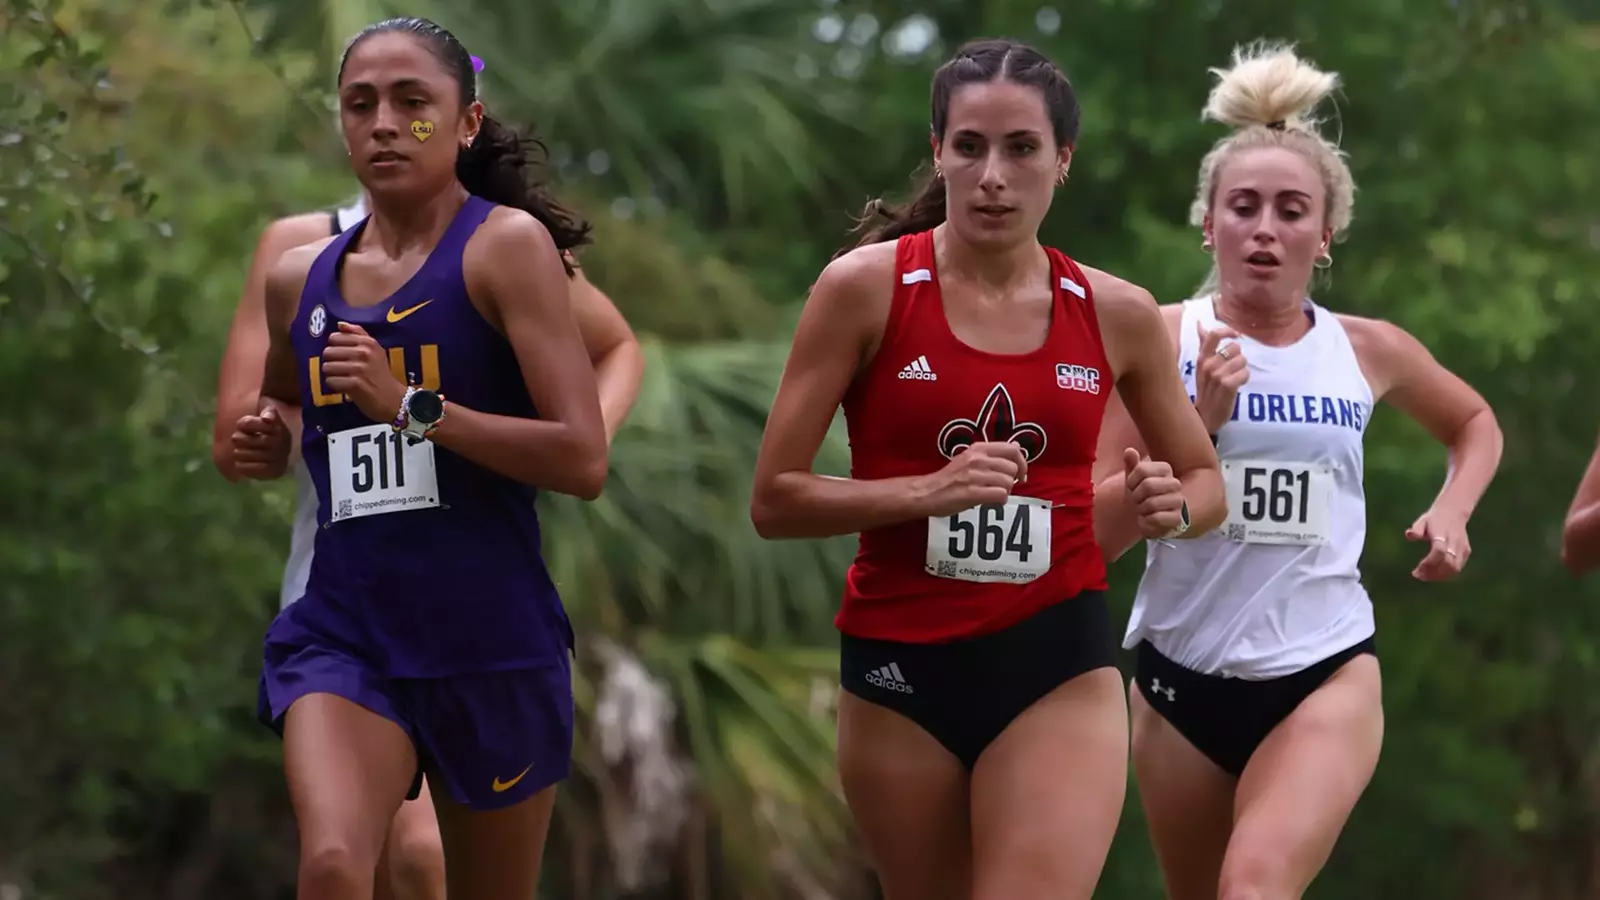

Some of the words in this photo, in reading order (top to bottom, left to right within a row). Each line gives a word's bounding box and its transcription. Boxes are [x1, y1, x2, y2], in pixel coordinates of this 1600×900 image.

[309, 344, 440, 407] LU
[898, 369, 937, 381] adidas
[1056, 363, 1100, 395] SBC
[1247, 393, 1362, 432] ORLEANS
[352, 431, 405, 493] 511
[354, 495, 426, 511] chippedtiming.com
[1242, 467, 1309, 524] 561
[948, 504, 1033, 562] 564
[959, 567, 1036, 579] chippedtiming.com
[865, 673, 914, 695] adidas
